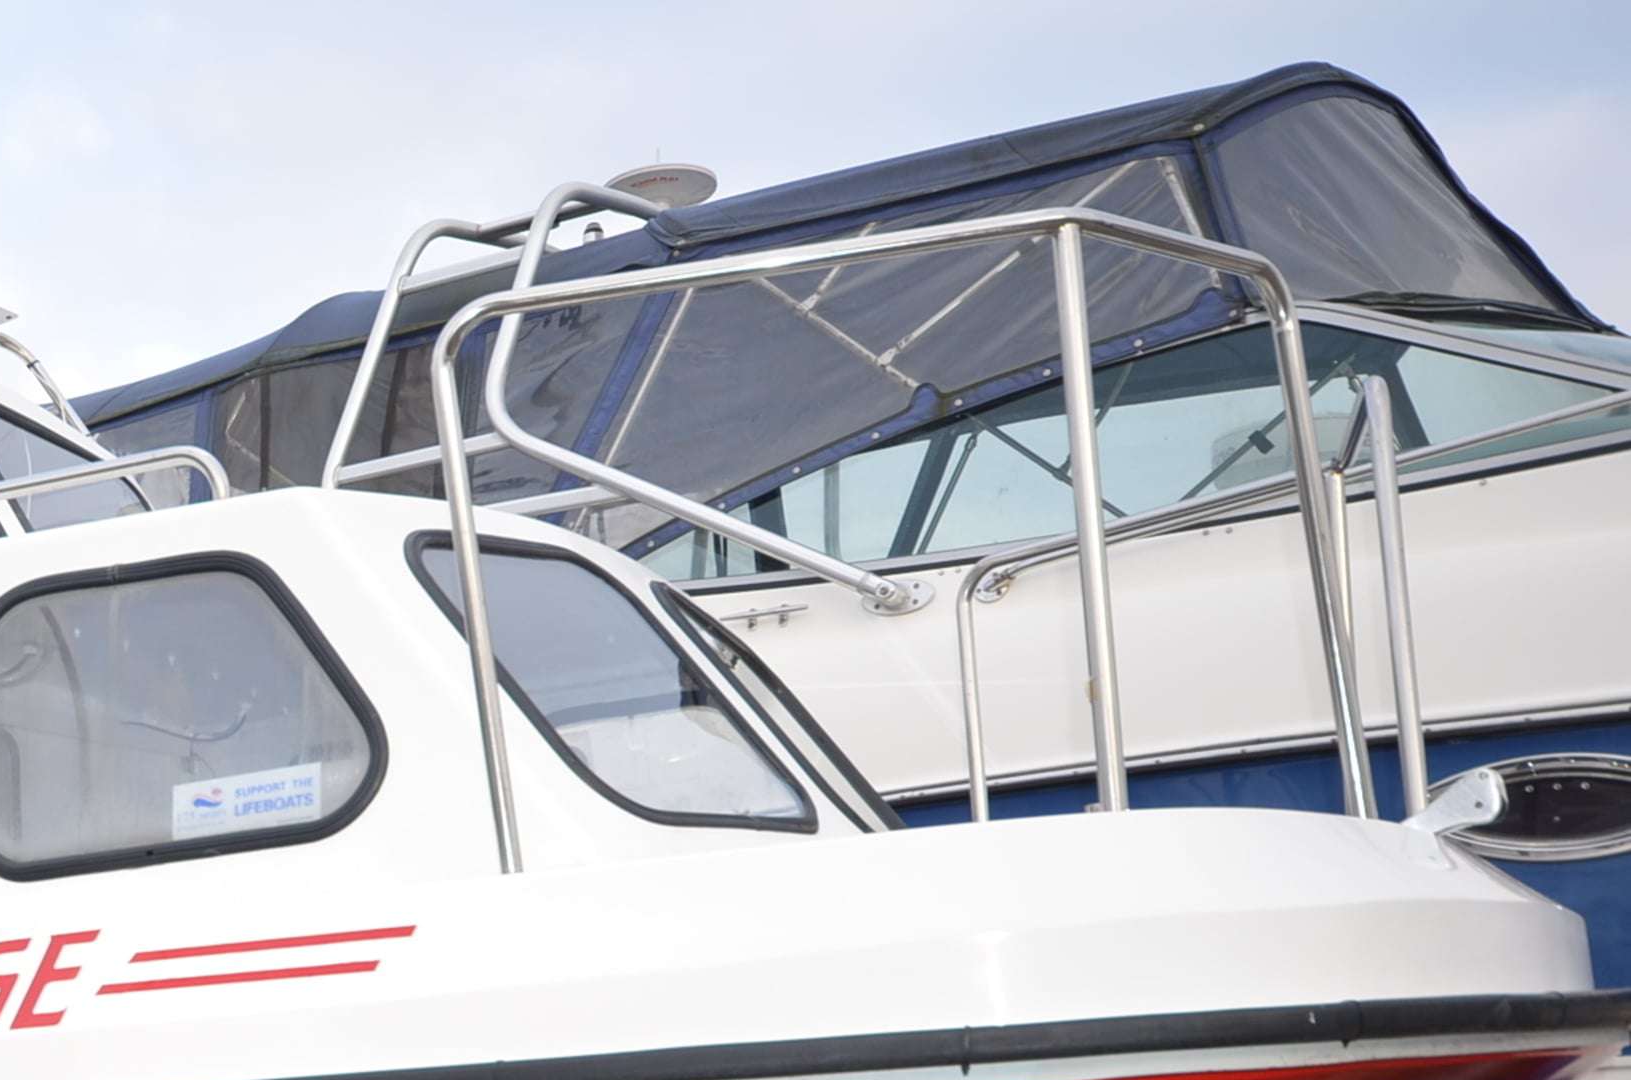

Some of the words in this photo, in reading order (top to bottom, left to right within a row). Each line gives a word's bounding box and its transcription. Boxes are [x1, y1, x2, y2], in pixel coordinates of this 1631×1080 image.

[235, 781, 286, 798] SUPPORT
[293, 776, 314, 789] THE
[233, 792, 315, 817] LIFEBOATS
